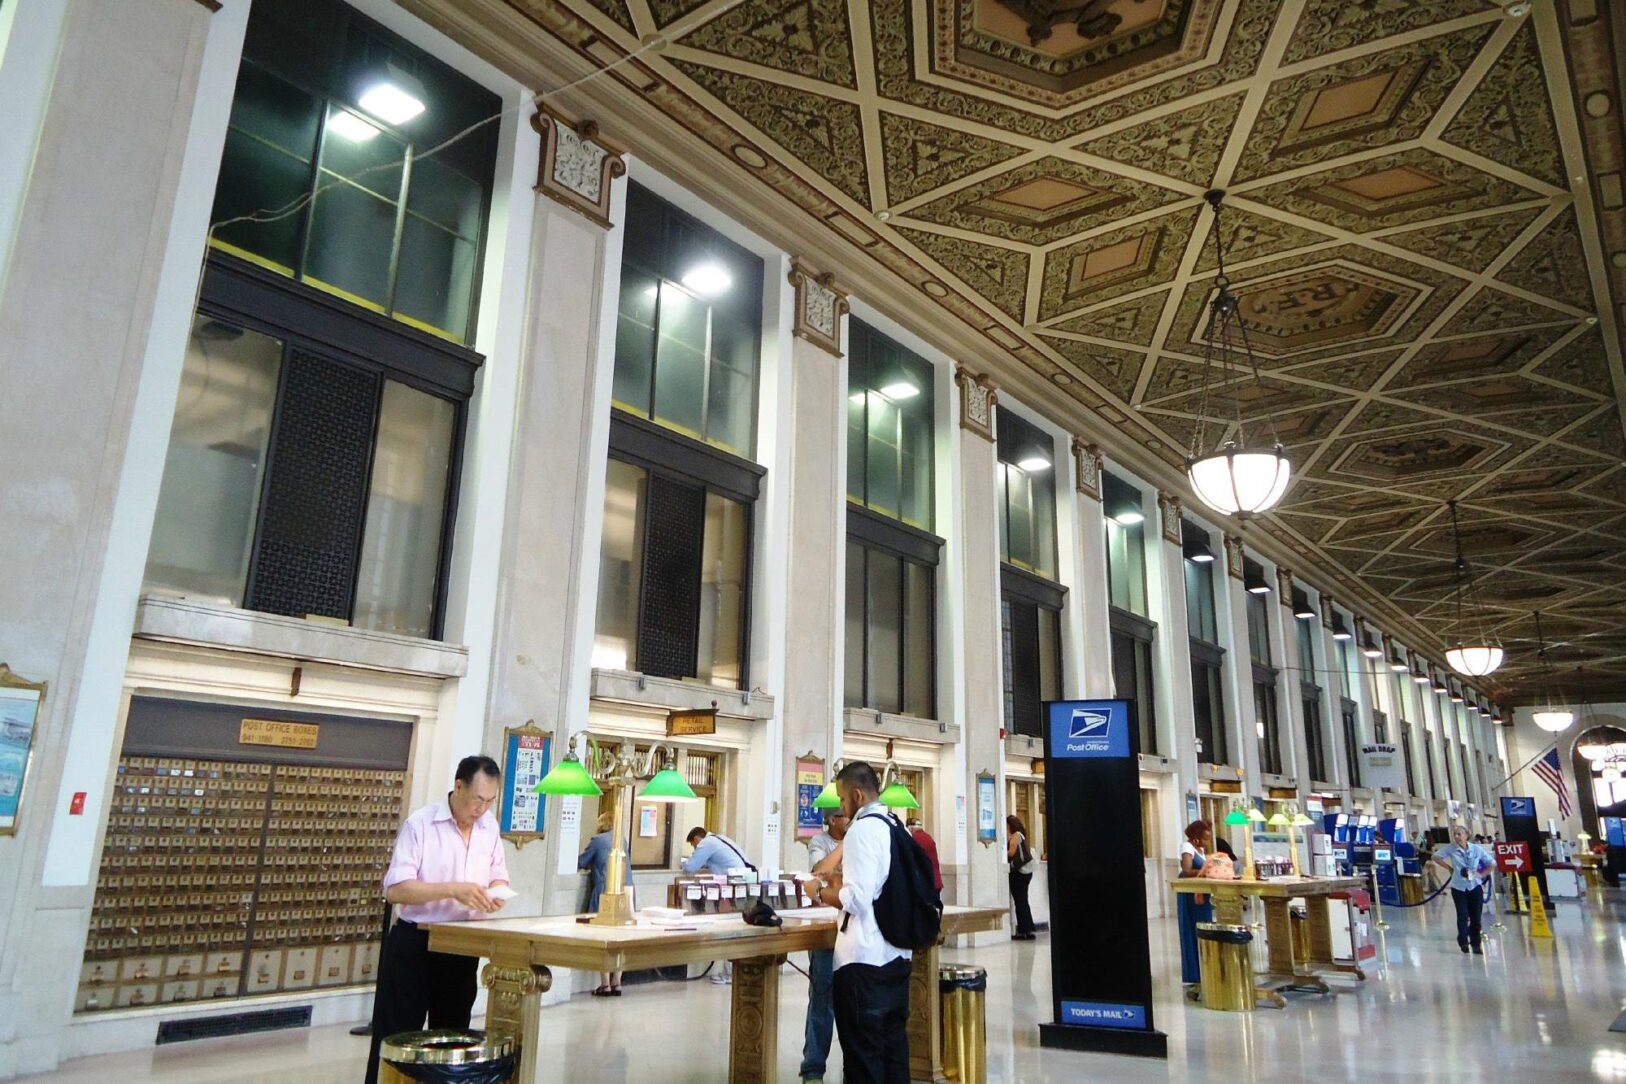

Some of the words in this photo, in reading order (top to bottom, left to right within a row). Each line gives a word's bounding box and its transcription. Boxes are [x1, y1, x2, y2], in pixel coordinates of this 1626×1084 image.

[243, 720, 263, 731] POST
[266, 723, 291, 734] OFFICE
[293, 725, 317, 736] BOXES
[1066, 743, 1084, 752] Post
[1085, 743, 1110, 751] Office
[1497, 843, 1524, 855] EXIT
[1070, 1008, 1102, 1018] TODAY'S
[1103, 1010, 1123, 1019] MAIL
